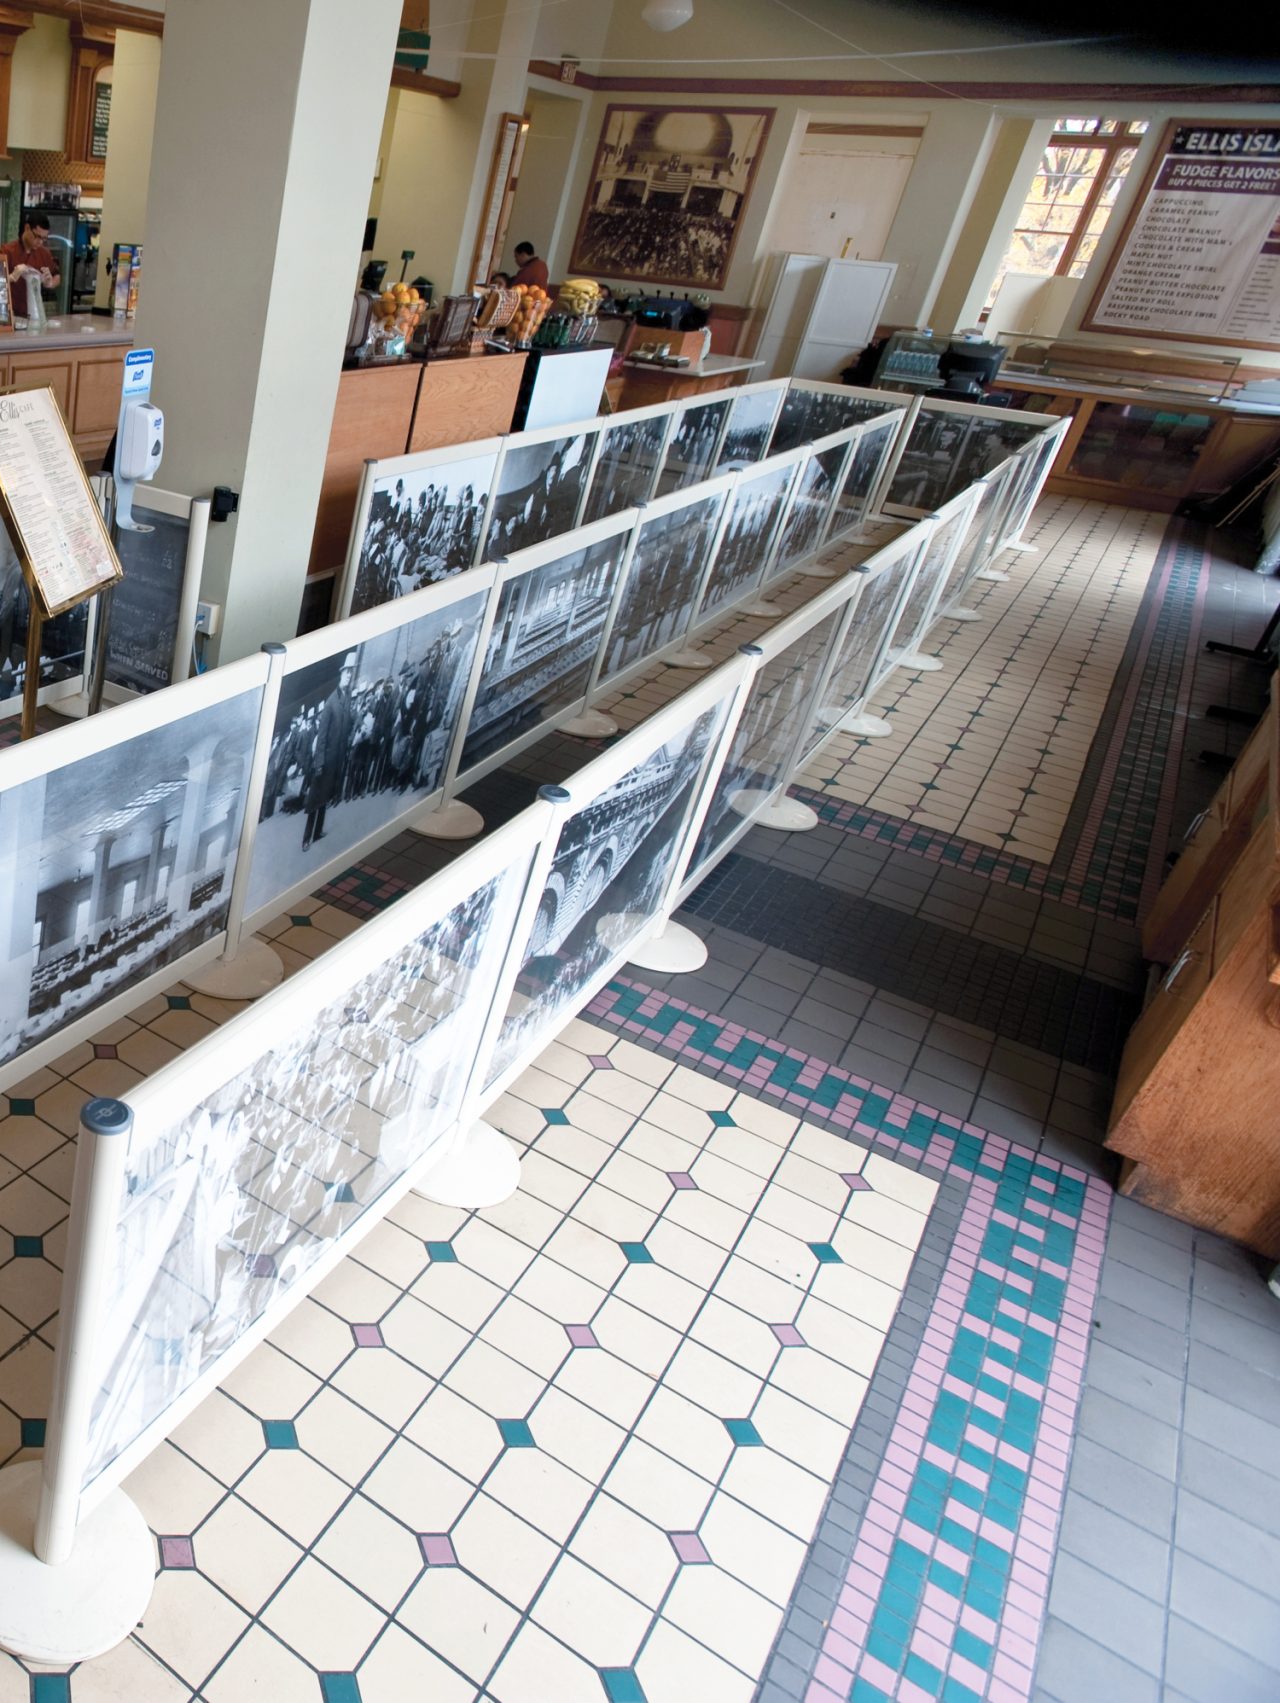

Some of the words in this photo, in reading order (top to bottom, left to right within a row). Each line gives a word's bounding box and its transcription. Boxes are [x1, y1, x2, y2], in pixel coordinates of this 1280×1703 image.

[1185, 132, 1242, 151] ELLIS
[1172, 164, 1219, 178] FUDGE
[1219, 166, 1280, 180] FLAVORS
[1168, 178, 1187, 187] BUY
[1193, 179, 1222, 189] PIECES
[1223, 180, 1241, 189] GET
[1248, 181, 1271, 190] FREE
[1154, 198, 1204, 206] CAPPUCCINO
[1150, 207, 1186, 215] CARAMEL
[1187, 209, 1219, 217] PEANUT
[1146, 216, 1191, 225] CHOCOLATE
[1142, 225, 1186, 234] CHOCOLATE
[1188, 227, 1222, 236] WALNUT
[1138, 234, 1182, 243] CHOCOLATE
[1184, 236, 1205, 245] WITH
[1134, 243, 1167, 251] COOKIES
[1175, 246, 1203, 254] CREAM
[1130, 251, 1154, 259] MAPLE
[1146, 261, 1192, 271] CHOCOLATE
[1193, 265, 1217, 274] SWIRL
[1122, 269, 1153, 278] ORANGE
[1154, 271, 1181, 279] CREAM
[1118, 277, 1149, 286] PEANUT
[1149, 279, 1180, 288] BUTTER
[1180, 282, 1227, 293] CHOCOLATE
[1114, 285, 1145, 294] PEANUT
[1145, 288, 1175, 297] BUTTER
[1175, 291, 1221, 301] EXPLOSION
[1111, 294, 1139, 302] SALTED
[1156, 298, 1176, 306] ROLL
[1103, 311, 1128, 319] ROCKY
[1128, 313, 1151, 321] ROAD
[1107, 302, 1148, 312] RASPBERRY
[1149, 306, 1194, 317] CHOCOLATE
[1194, 311, 1218, 319] SWIRL
[128, 354, 152, 363] Complimentary
[0, 400, 20, 422] Ellis
[134, 658, 169, 681] SERVED
